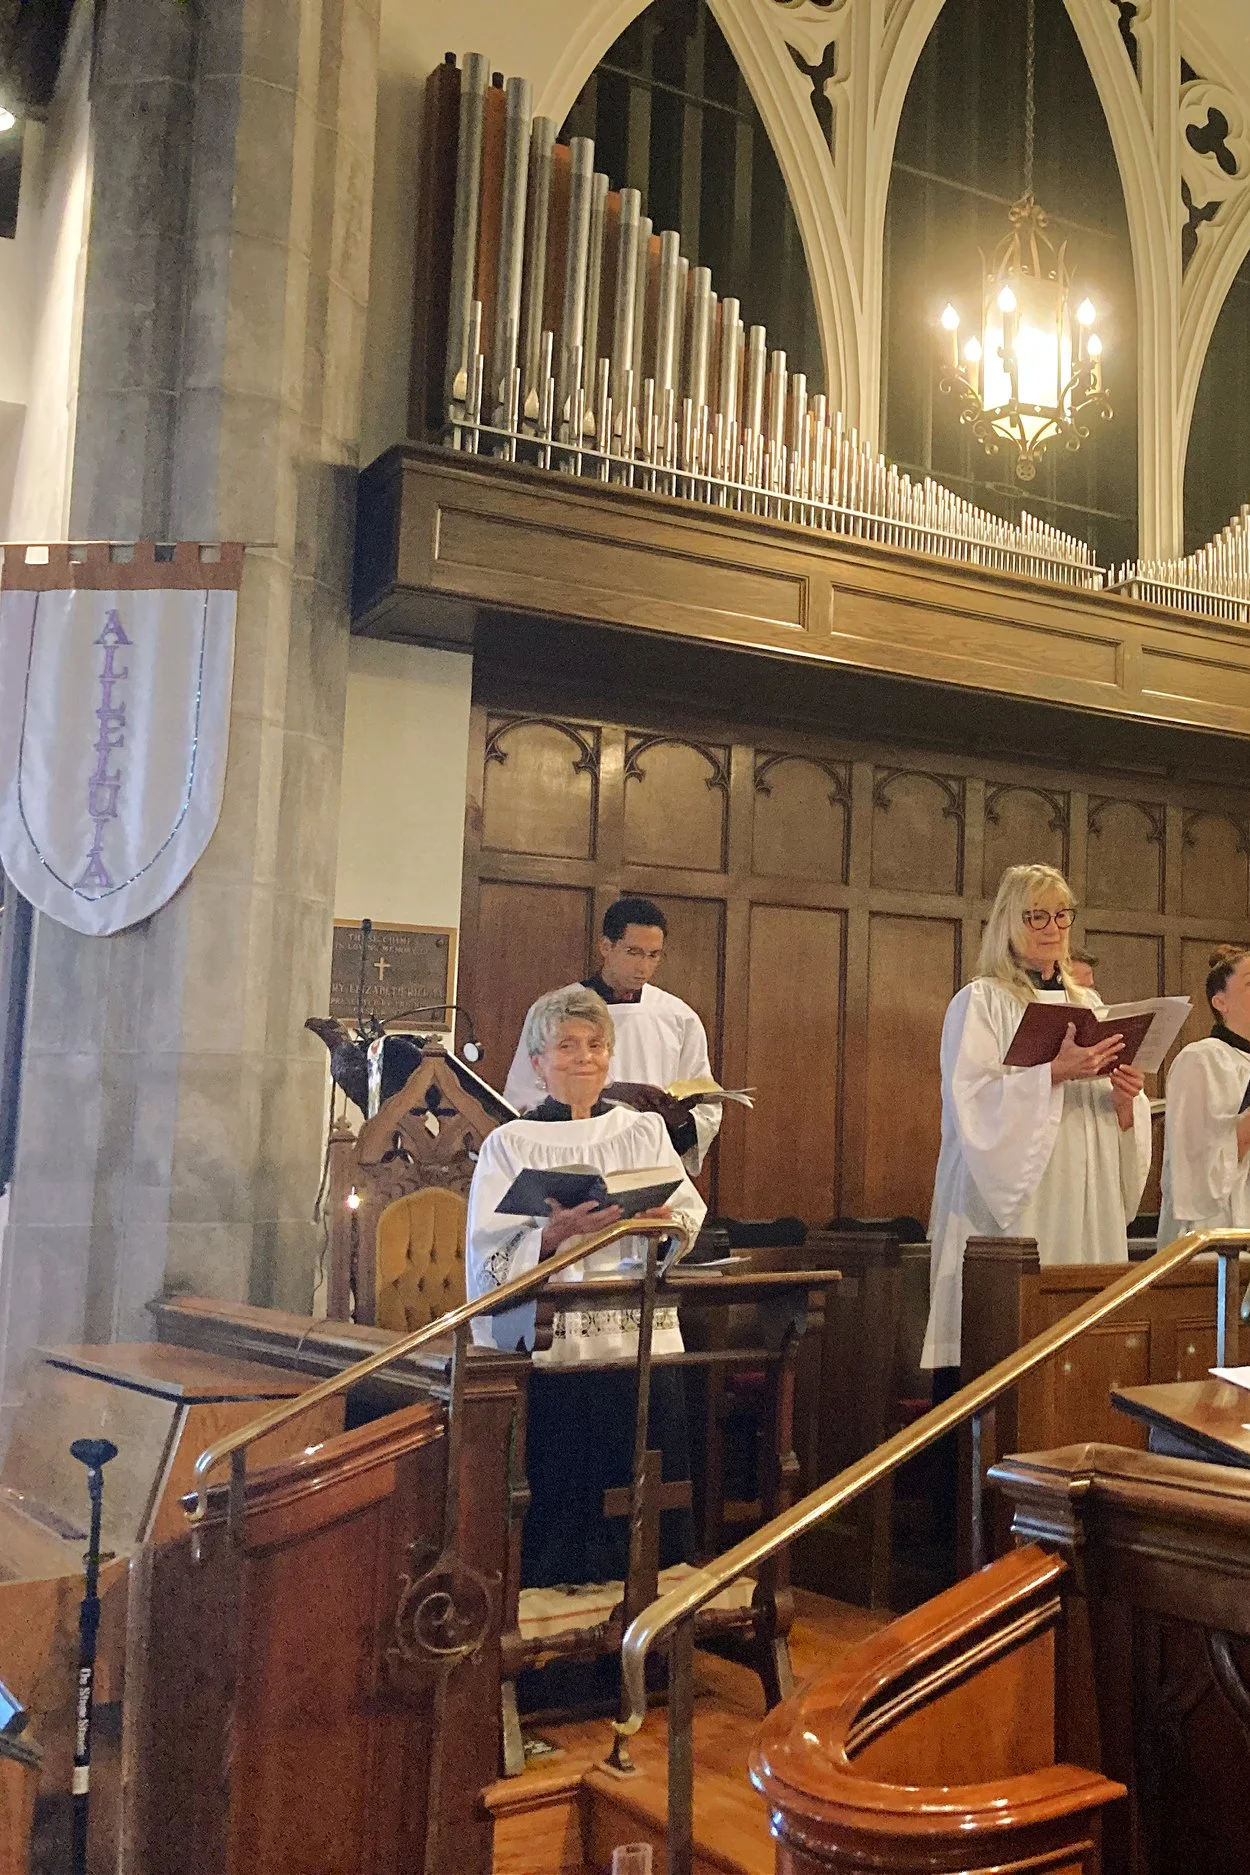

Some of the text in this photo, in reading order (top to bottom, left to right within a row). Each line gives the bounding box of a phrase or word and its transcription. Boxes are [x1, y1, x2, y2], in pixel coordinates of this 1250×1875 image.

[74, 608, 133, 889] ALLELUIA
[348, 933, 378, 943] THSE
[347, 943, 378, 951] LOVNG
